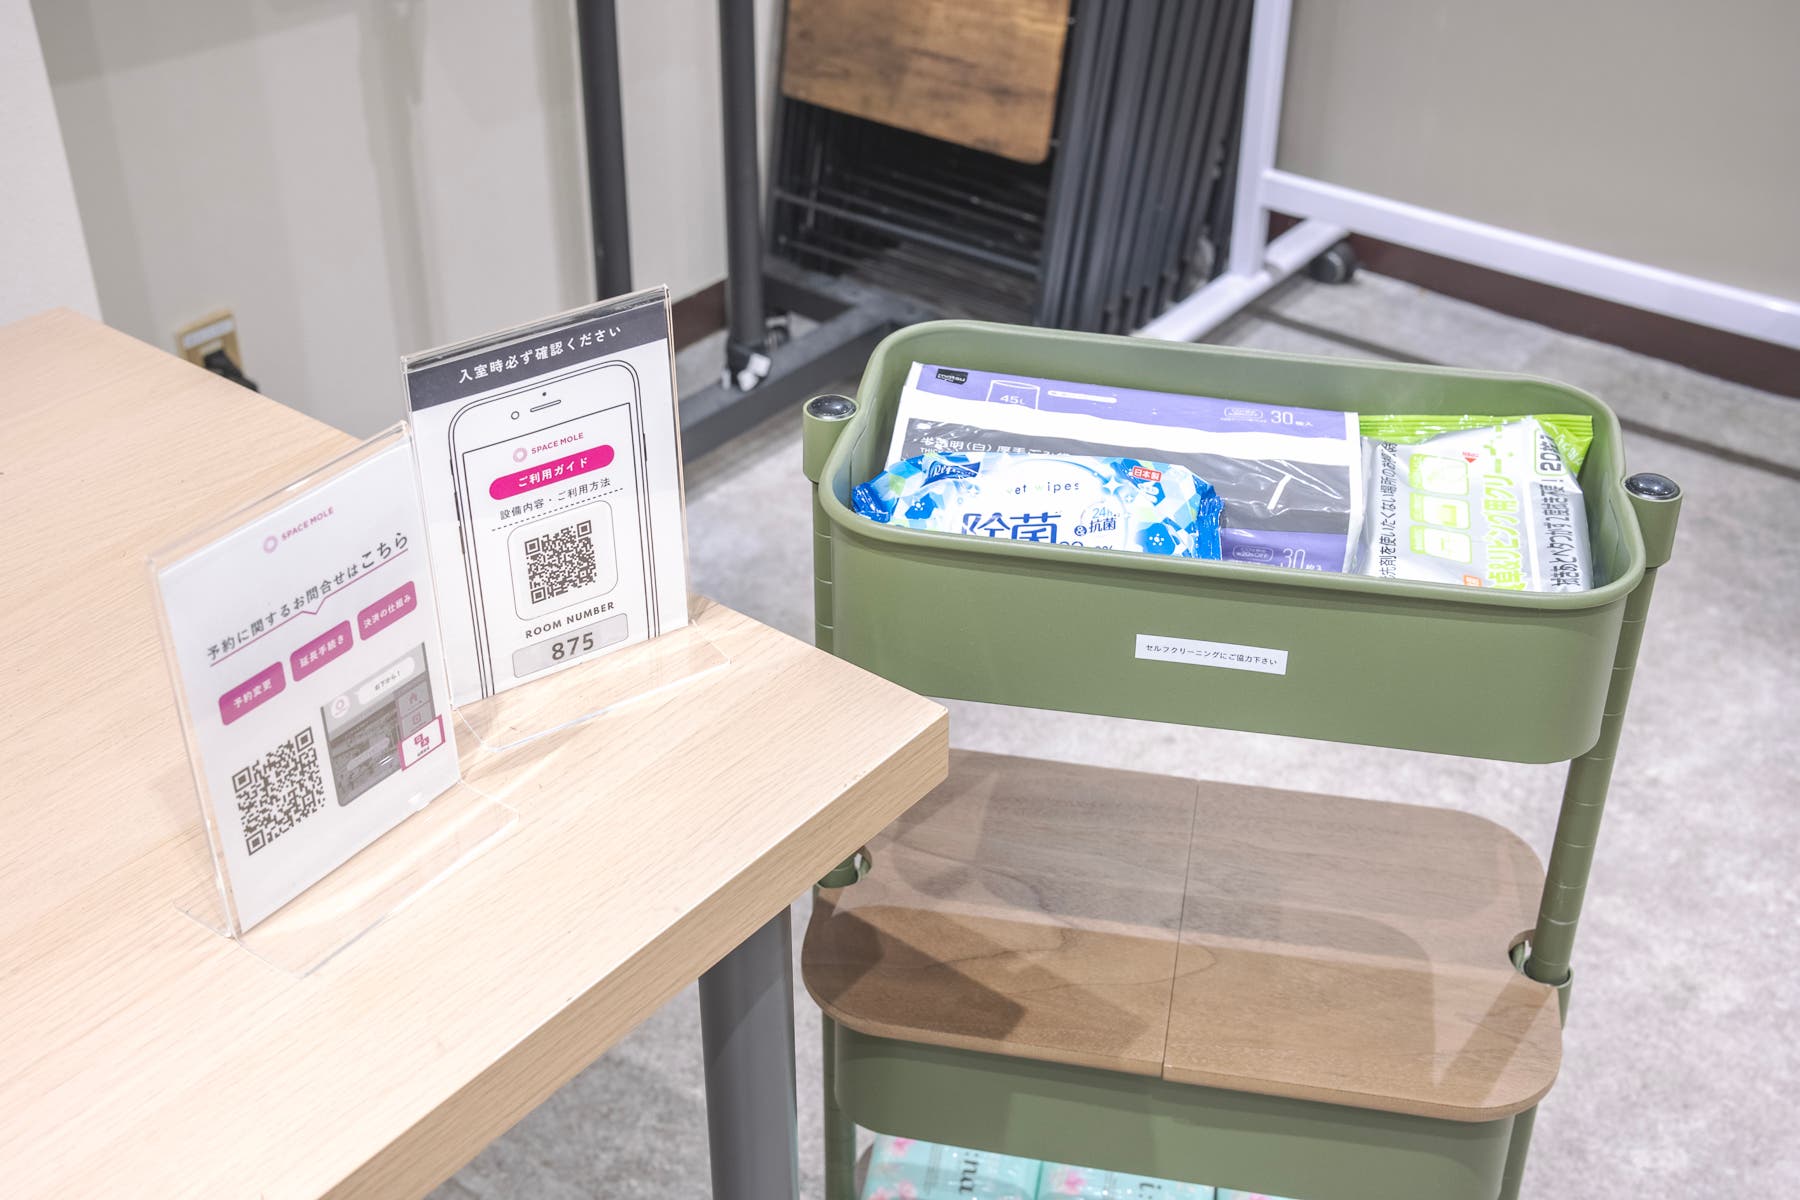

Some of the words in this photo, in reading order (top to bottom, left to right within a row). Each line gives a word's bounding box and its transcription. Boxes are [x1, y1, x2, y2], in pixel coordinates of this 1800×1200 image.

[458, 326, 621, 384] 入室時必ず確認ください
[531, 439, 559, 455] SPACE
[560, 432, 584, 446] MOLE
[517, 457, 589, 488] ご利用ガイド
[1133, 468, 1160, 480] 日本製
[499, 477, 611, 520] 設備内容・ご利用方法
[281, 520, 310, 542] SPACE
[310, 507, 335, 525] MOLE
[1089, 520, 1117, 533] 抗菌
[207, 532, 408, 661] 予約に関するお問合せはこちら
[363, 594, 412, 629] 決済の仕組み
[525, 620, 562, 639] ROOM
[566, 601, 615, 624] NUMBER
[299, 634, 345, 669] 延長手続き
[551, 632, 594, 661] 875
[1145, 644, 1278, 665] セルフクリーニングにご協力下さい
[232, 678, 273, 709] 予約変更
[958, 1150, 980, 1195] :na
